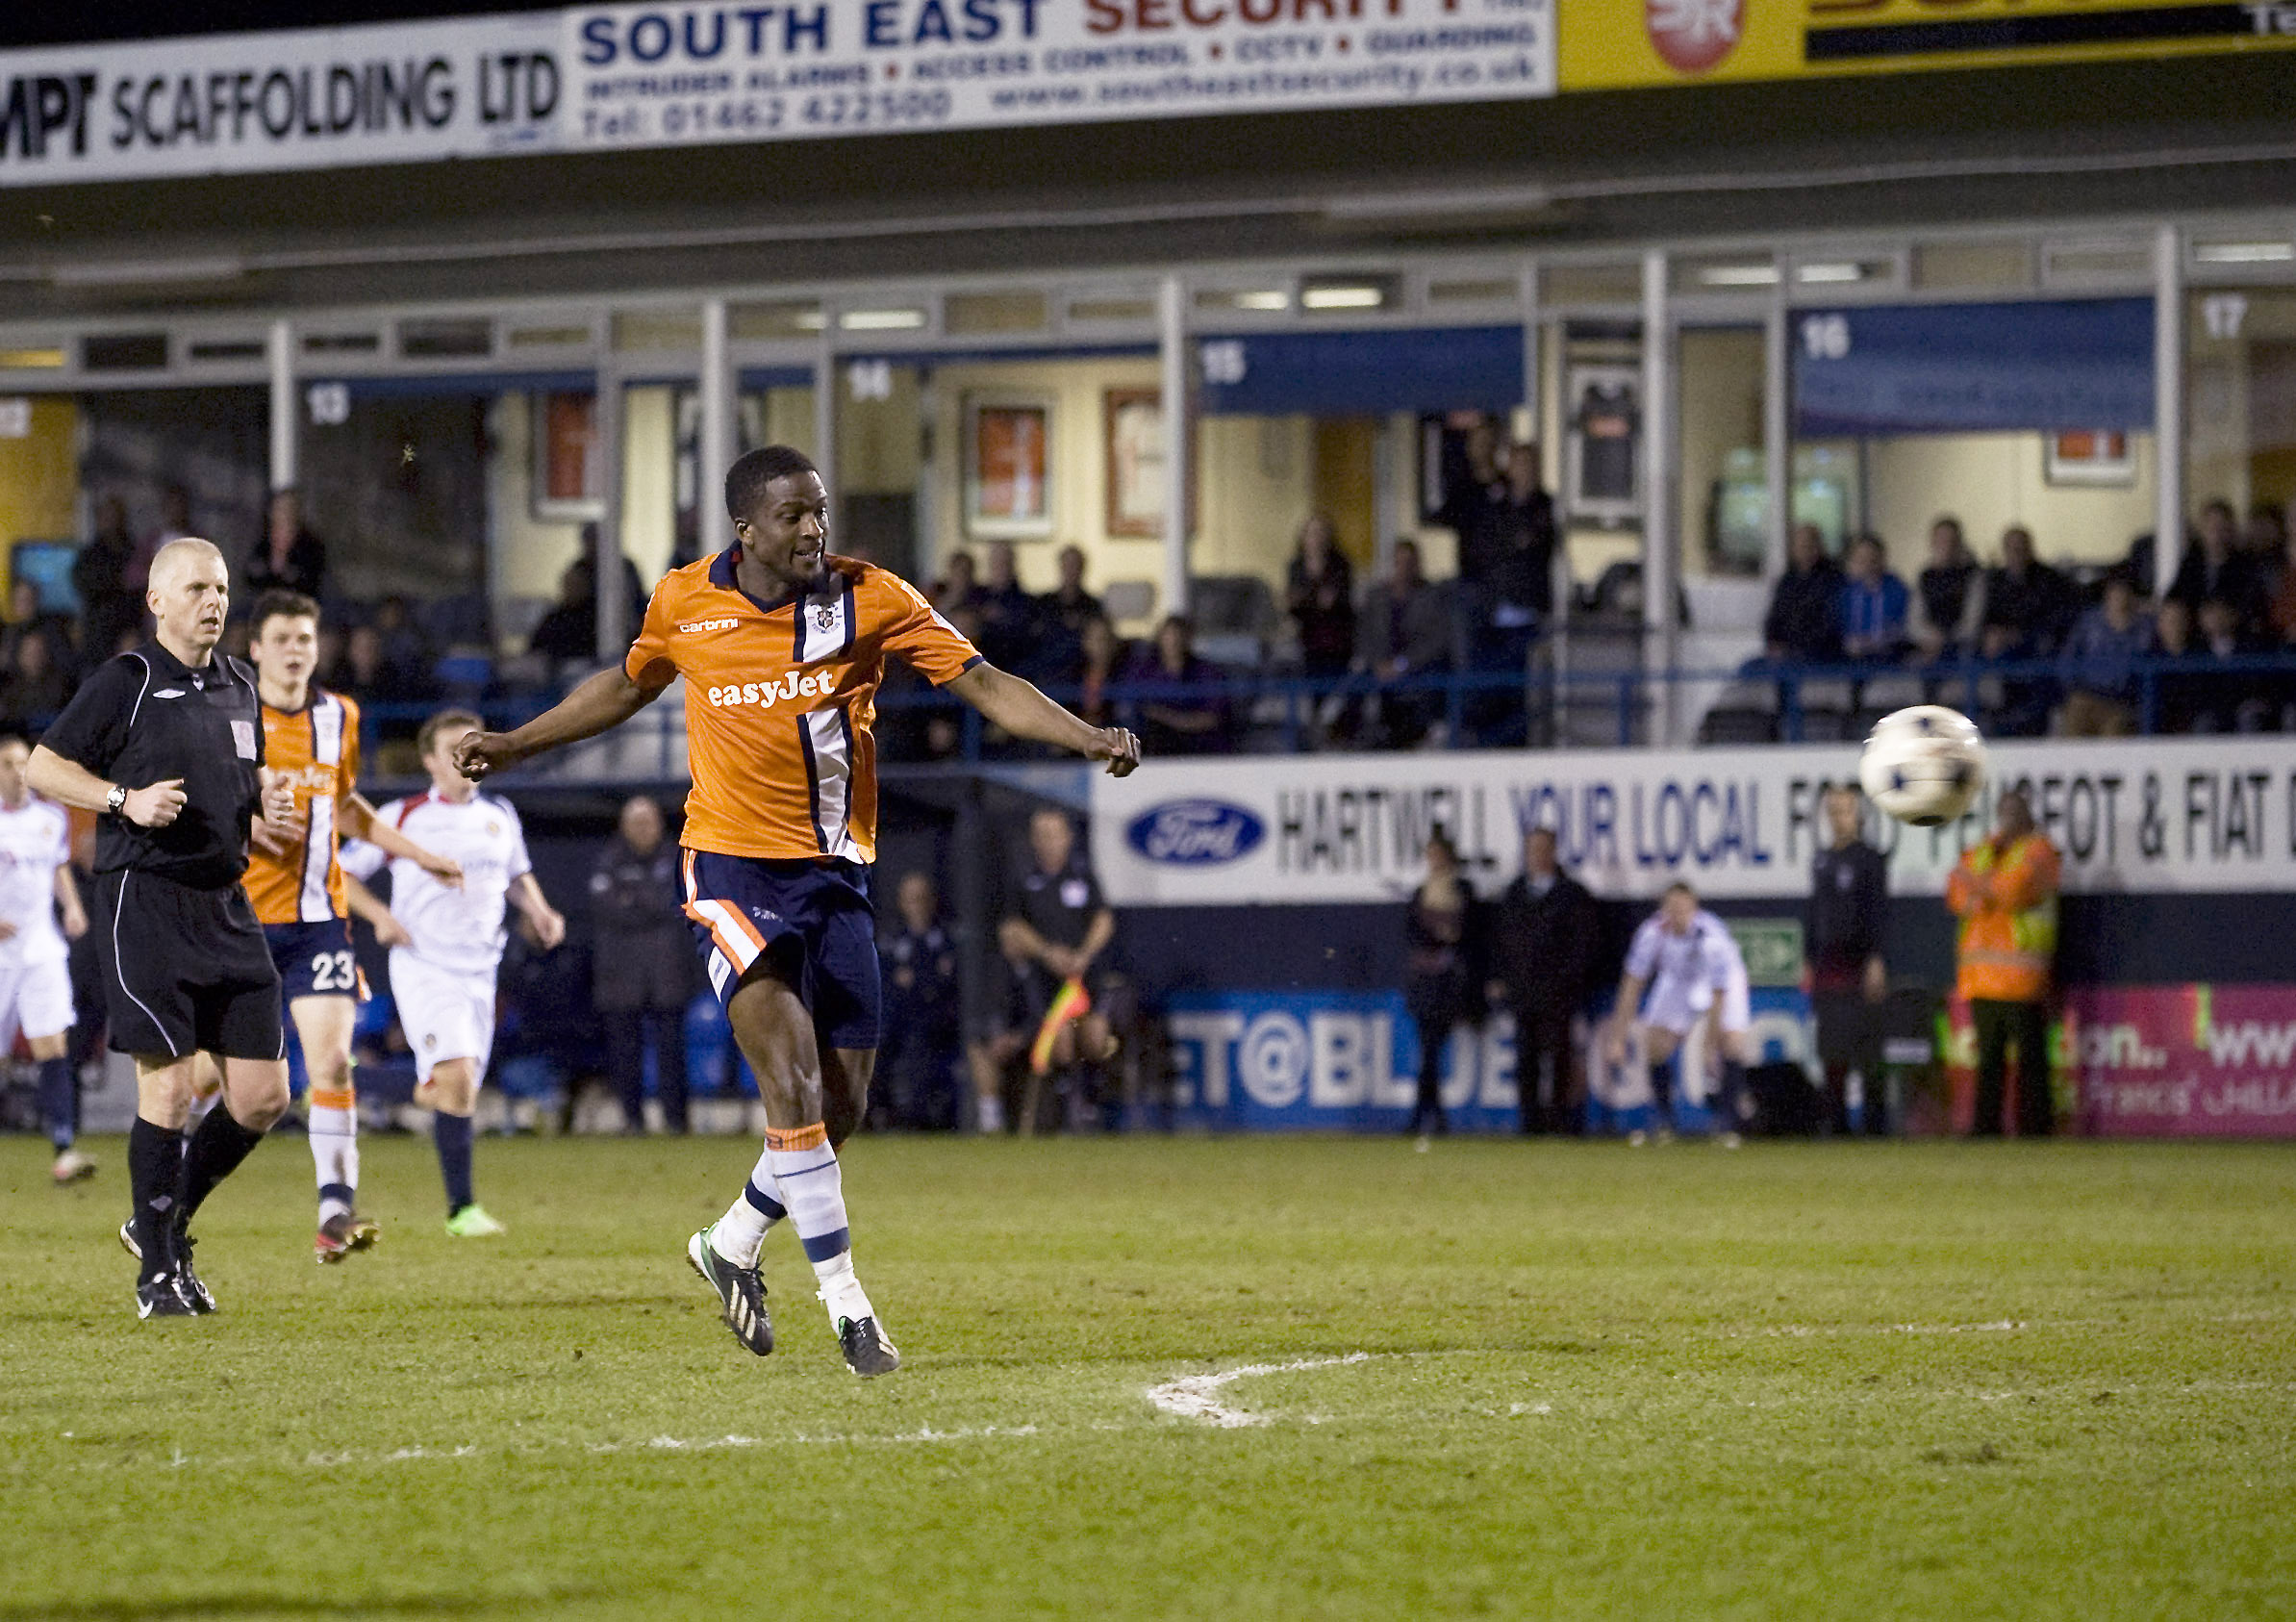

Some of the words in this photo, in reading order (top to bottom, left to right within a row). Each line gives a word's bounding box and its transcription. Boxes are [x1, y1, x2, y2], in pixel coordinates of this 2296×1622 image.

[581, 8, 829, 65] SOUTH
[866, 0, 1043, 47] EAST
[1086, 0, 1460, 35] SECU
[913, 54, 1032, 79] ACCESS
[1235, 33, 1324, 62] CCTV
[112, 58, 456, 150] SCAFFOLDING
[480, 53, 562, 123] LTD
[708, 670, 836, 709] easyJet
[1277, 783, 1497, 874] HARTWELL
[1512, 779, 1618, 869] YOUR
[1637, 777, 1770, 868] LOCAL
[2138, 770, 2168, 858] &
[2184, 770, 2270, 862] FIAT
[312, 950, 355, 991] 23
